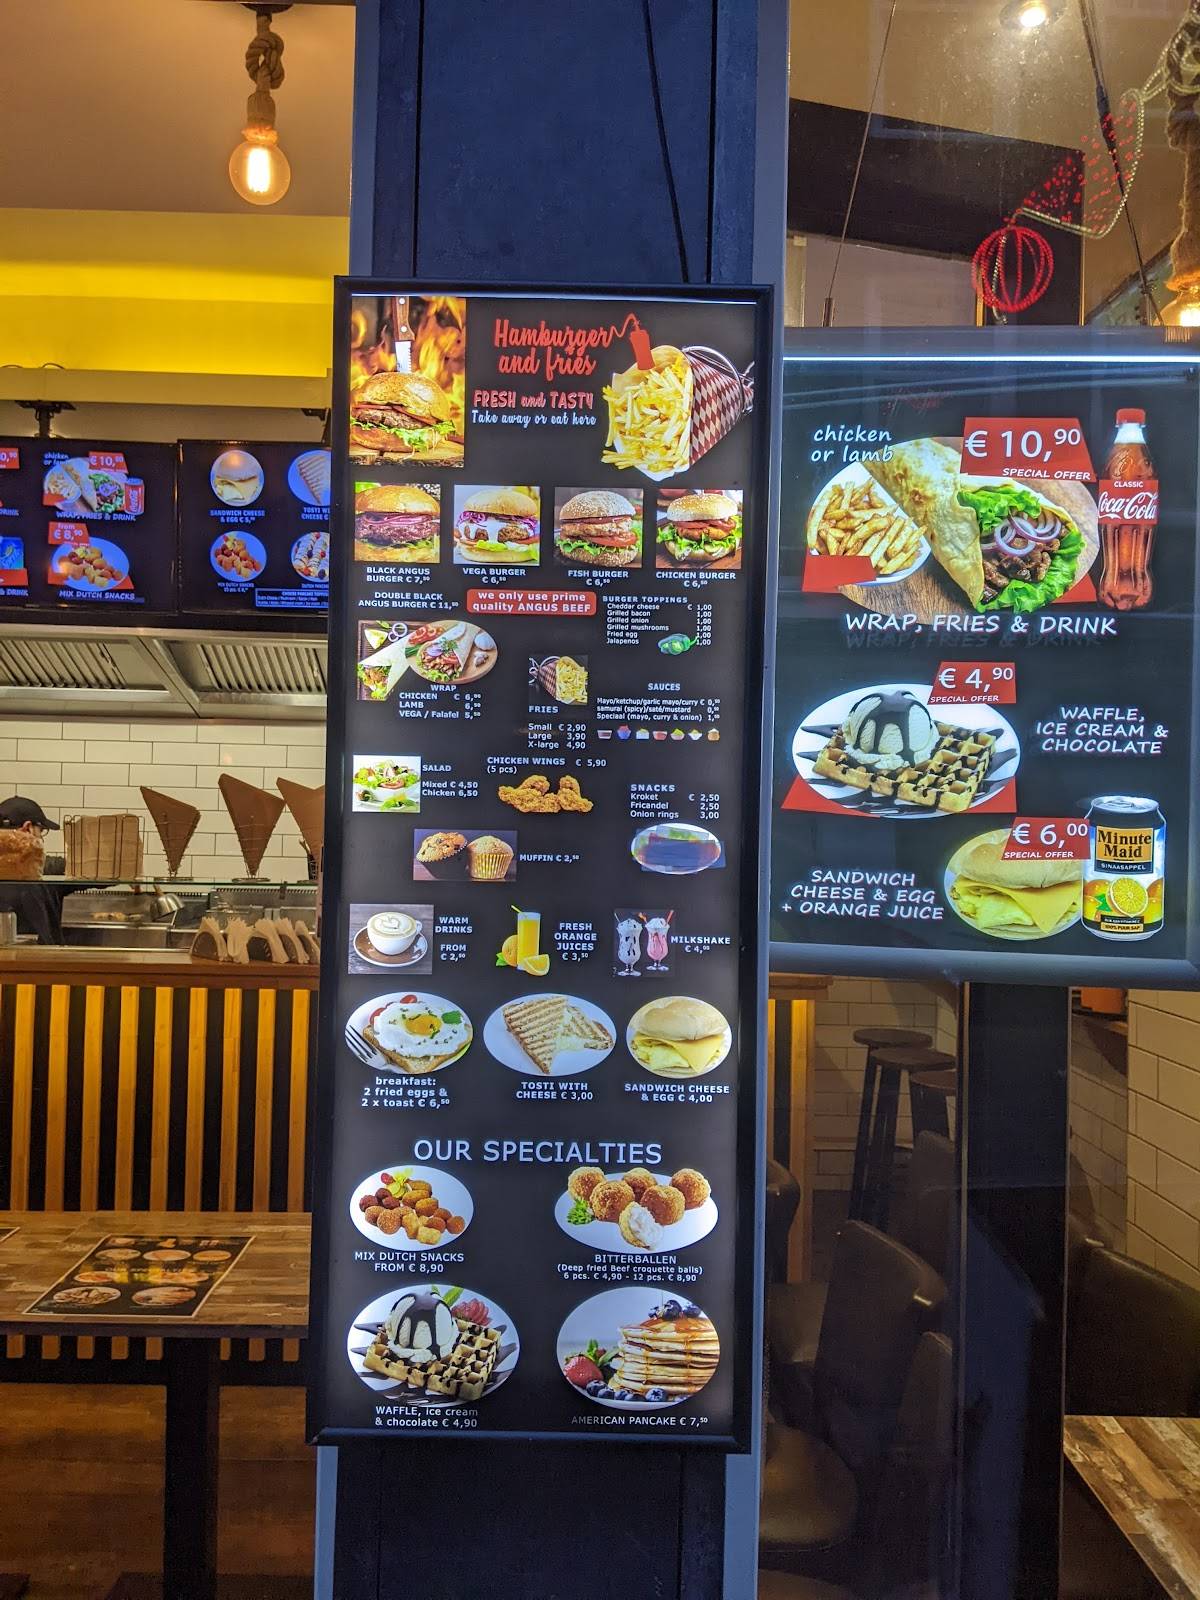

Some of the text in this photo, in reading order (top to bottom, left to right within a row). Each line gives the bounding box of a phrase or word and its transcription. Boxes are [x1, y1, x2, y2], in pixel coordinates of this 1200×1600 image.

[494, 319, 612, 355] Hamburger
[498, 346, 597, 381] and fries
[473, 389, 594, 409] FRESH and TASTY
[471, 410, 597, 429] Take away or eat here
[813, 424, 892, 442] chicken
[965, 428, 1081, 462] € 10,90
[810, 445, 894, 463] or lamb
[1002, 467, 1091, 480] SPECIAL OFFER
[1098, 491, 1158, 520] Coca-Cola
[366, 566, 431, 576] BLACK ANGUS
[462, 567, 526, 576] VEGA BURGER
[568, 570, 629, 579] FISH BURGER
[655, 571, 737, 580] CHICKEN BURGER
[366, 574, 404, 583] BURGER
[374, 591, 443, 601] DOUBLE BLACK
[478, 592, 495, 600] we
[498, 591, 524, 601] only
[552, 592, 586, 602] prime
[602, 595, 688, 604] BURGER TOPPINGS
[358, 599, 428, 609] ANGUS BURGER
[472, 602, 591, 613] quality ANGUS BEEF
[845, 613, 1118, 635] WRAP, FRIES & DRINK
[938, 667, 1013, 692] € 4,90
[430, 684, 457, 692] WRAP
[647, 683, 681, 691] SAUCES
[399, 692, 438, 700] CHICKEN
[930, 694, 999, 703] SPECIAL OFFER
[399, 701, 424, 709] LAMB
[528, 705, 559, 713] FRIES
[399, 710, 460, 719] VEGA Falafel
[1060, 706, 1145, 723] WAFFLE,
[528, 723, 586, 732] Small 2,90
[1036, 722, 1169, 738] ICE CREAM &
[528, 732, 552, 740] Large
[527, 741, 586, 750] X-large 4,90
[1042, 738, 1162, 755] CHOCOLATE
[486, 756, 607, 768] CHICKEN WINGS 5,90
[422, 764, 452, 772] SALAD
[422, 780, 479, 791] Mixed 4,50
[630, 784, 676, 792] SNACKS
[422, 789, 478, 798] Chicken 6,50
[630, 793, 659, 801] Kroket
[630, 810, 720, 820] Onion rings 3,00
[1012, 823, 1089, 849] € 6,00
[1097, 829, 1152, 845] Minute
[1004, 851, 1075, 859] SPECIAL OFFER
[1103, 843, 1143, 858] Maid
[519, 853, 554, 862] MUFFIN
[1101, 862, 1147, 870] SINAASAPPEL
[811, 869, 916, 887] SANDWICH
[791, 884, 936, 905] CHEESE & EGG
[781, 901, 944, 921] + ORANGE JUICE
[439, 916, 469, 925] WARM
[435, 925, 473, 934] DRINKS
[559, 922, 593, 931] FRESH
[554, 932, 597, 941] ORANGE
[670, 935, 731, 945] MILKSHAKE
[440, 944, 467, 952] FROM
[556, 942, 595, 951] JUICES
[375, 1076, 436, 1086] breakfast:
[521, 1081, 588, 1091] TOSTI WITH
[364, 1087, 435, 1099] 2 fried eggs
[624, 1083, 730, 1094] SANDWICH CHEESE
[515, 1090, 594, 1101] CHEESE 3,00
[653, 1094, 713, 1104] EGG 4,00
[361, 1098, 369, 1107] 2
[383, 1098, 414, 1107] toast
[413, 1139, 662, 1164] OUR SPECIALTIES
[354, 1251, 465, 1262] MIX DUTCH SNACKS
[594, 1254, 677, 1264] BITTERBALLEN
[374, 1263, 405, 1272] FROM
[419, 1263, 444, 1274] 8,90
[557, 1263, 704, 1275] (Deep fried Beef croquette balls)
[563, 1272, 570, 1280] 6
[572, 1273, 591, 1281] pcs.
[601, 1273, 622, 1282] 4,90
[647, 1274, 665, 1283] pcs.
[676, 1274, 697, 1283] 8,90
[375, 1405, 478, 1417] WAFFLE, ice cream
[374, 1417, 478, 1429] & chocolate 4,90
[571, 1415, 676, 1426] AMERICAN PANCAKE
